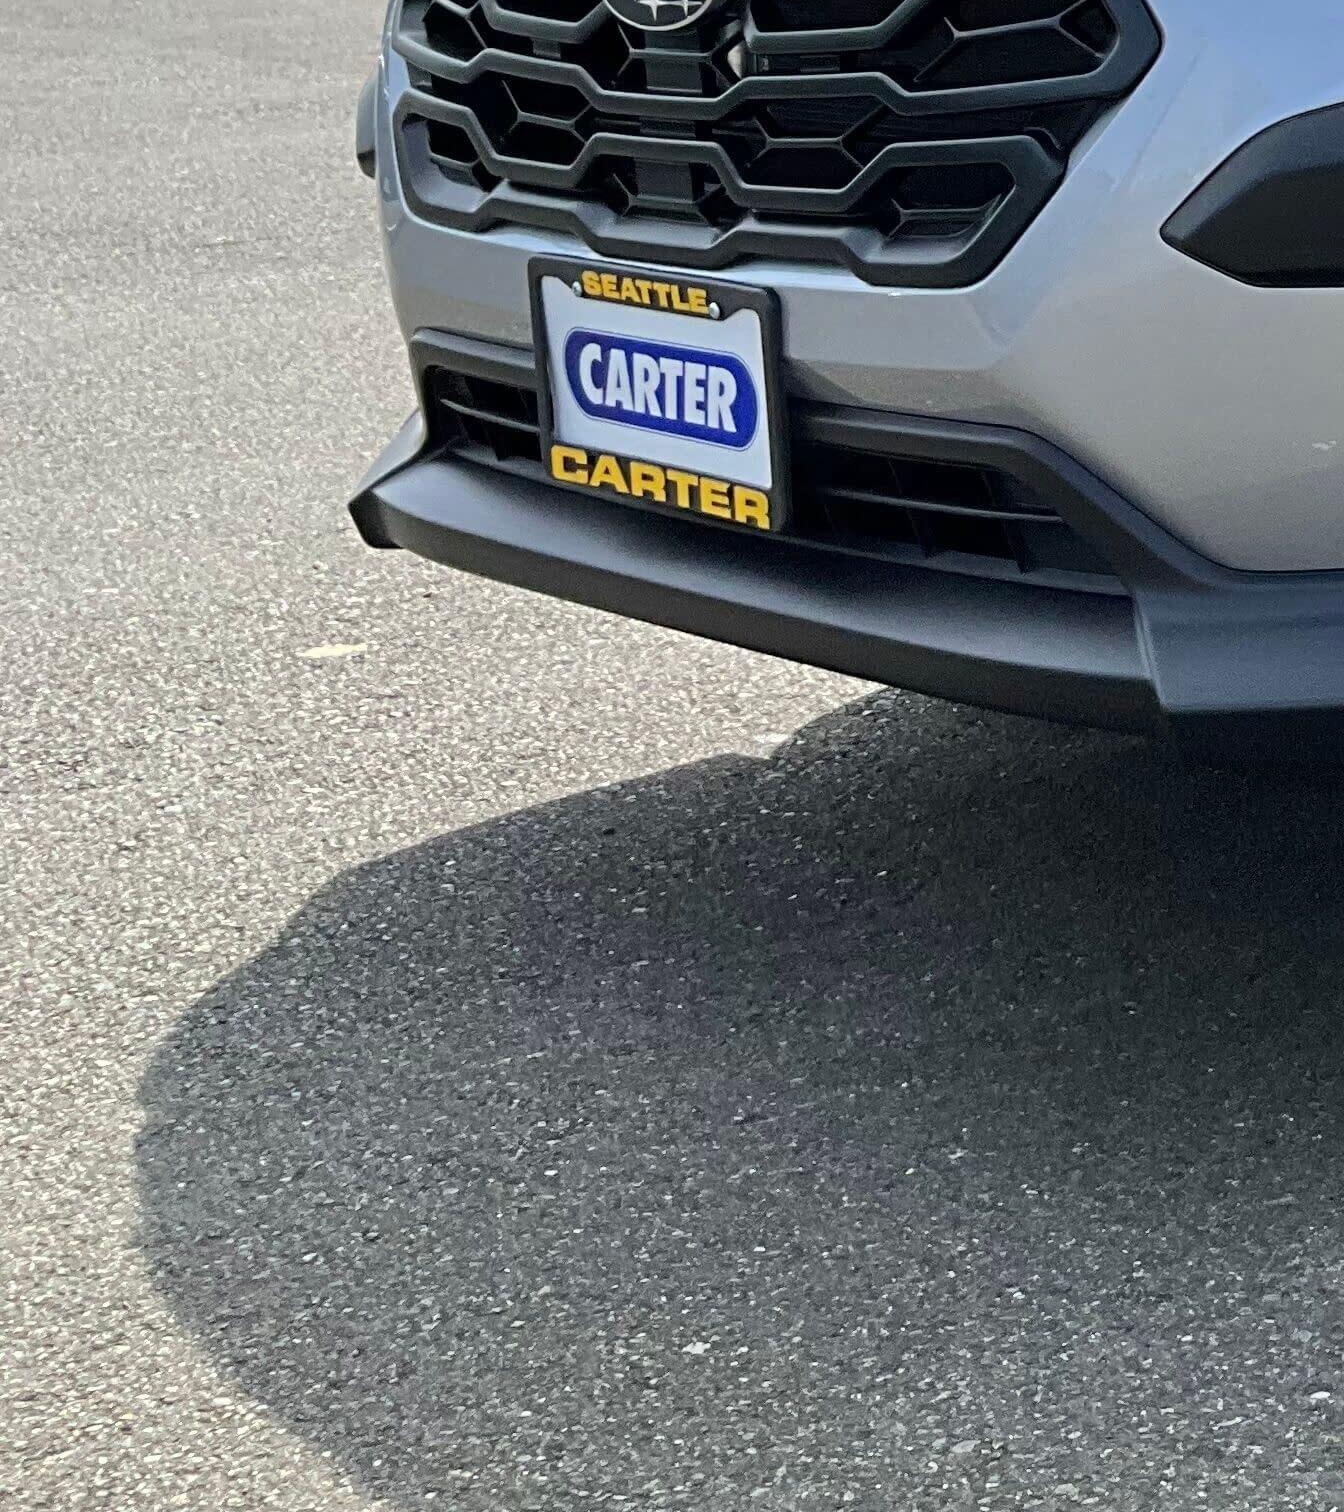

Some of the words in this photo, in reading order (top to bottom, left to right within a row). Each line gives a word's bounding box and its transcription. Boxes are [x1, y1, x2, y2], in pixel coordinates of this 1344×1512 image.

[580, 270, 710, 317] SEATTLE
[579, 342, 738, 434] CARTER
[550, 444, 771, 531] CARTER
